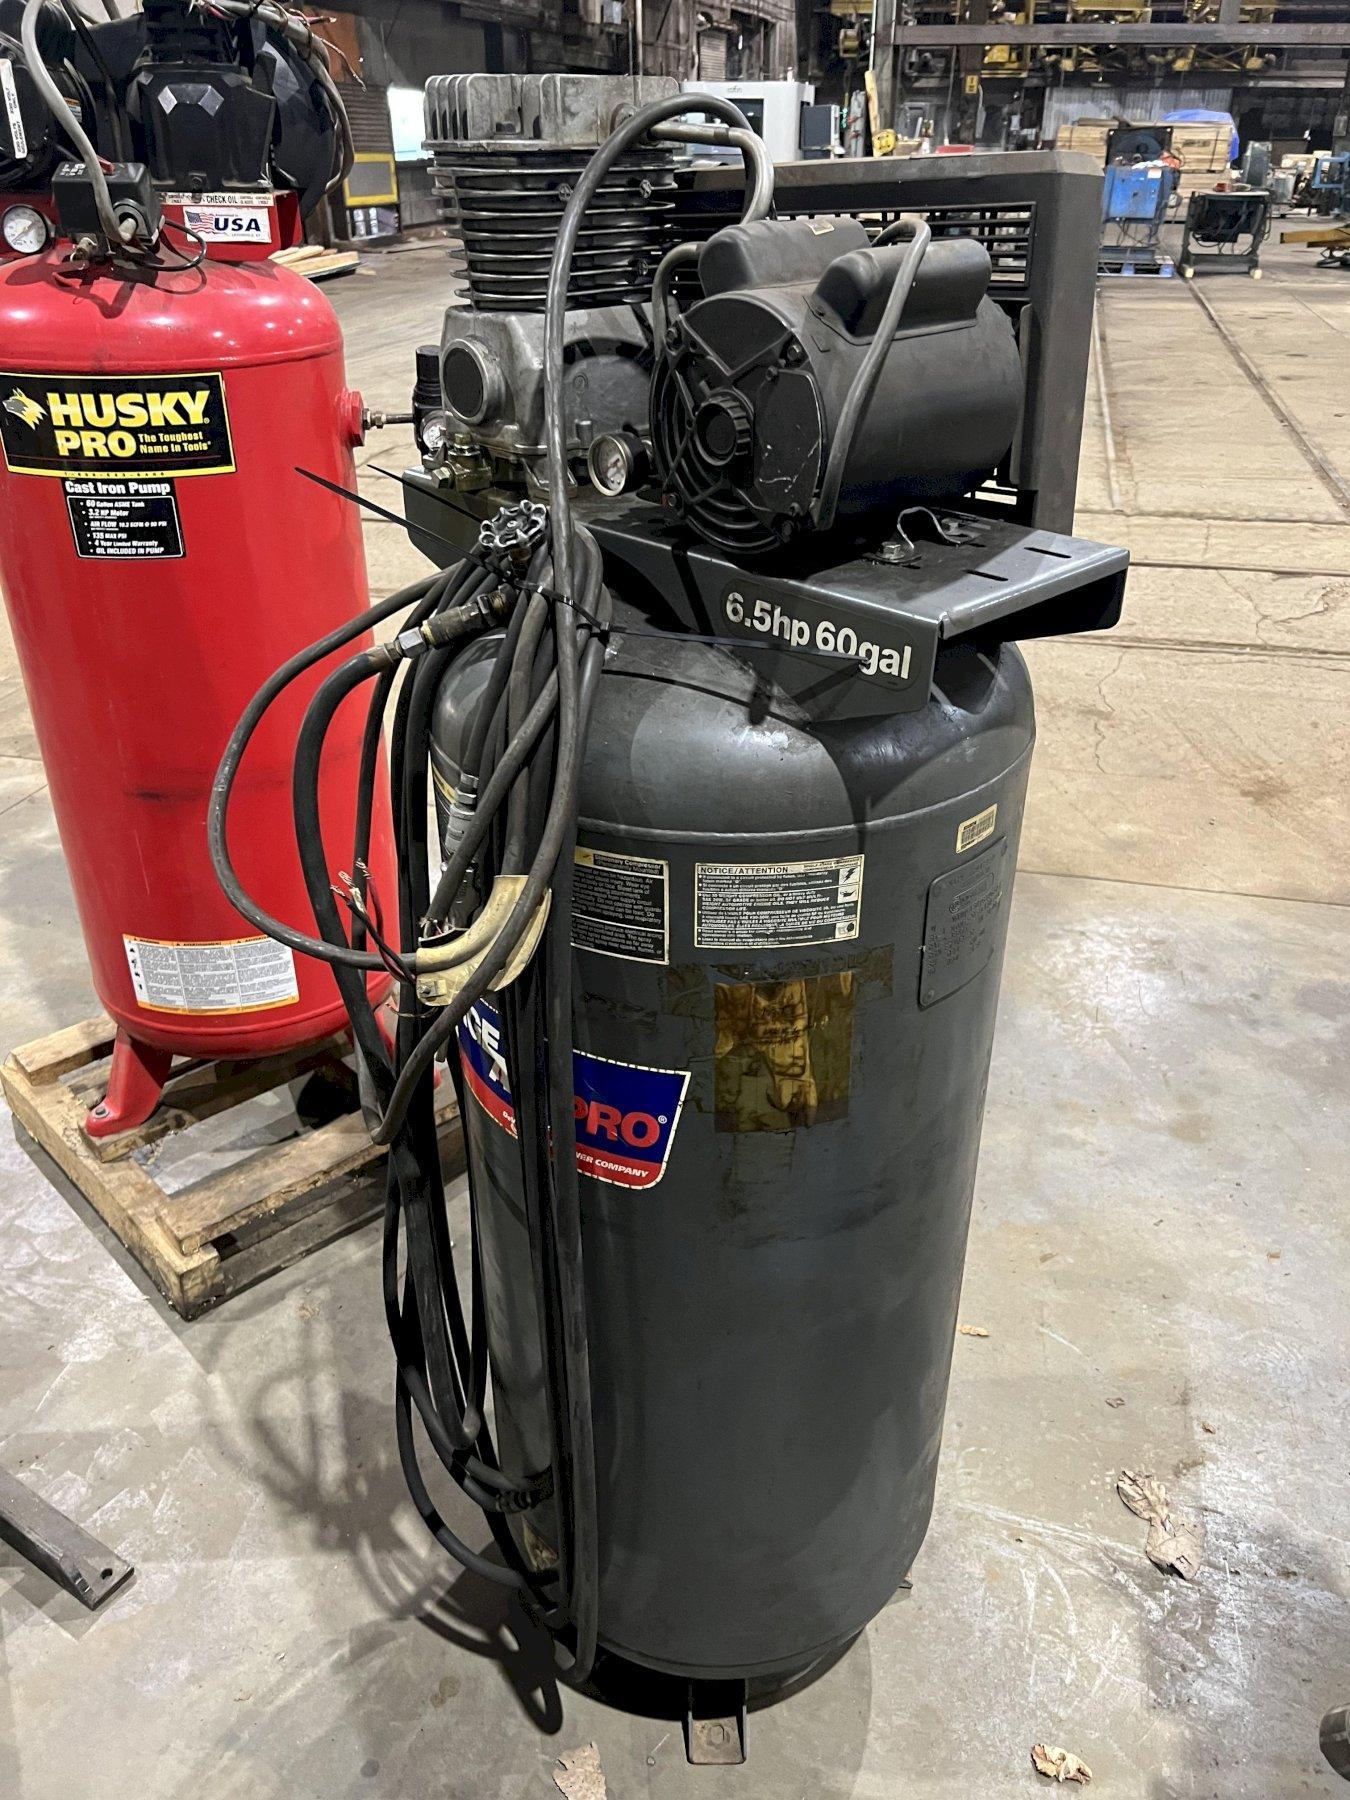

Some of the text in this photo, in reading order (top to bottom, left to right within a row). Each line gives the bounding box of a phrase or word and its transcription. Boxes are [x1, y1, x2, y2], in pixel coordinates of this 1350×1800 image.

[206, 195, 227, 204] CHECK
[227, 195, 238, 204] OIL
[214, 217, 261, 232] USA
[46, 390, 211, 428] HUSKY
[54, 430, 203, 458] PRO The Toughest
[139, 443, 169, 454] Name
[184, 441, 209, 452] Tools
[65, 480, 171, 496] Cast Iron Pump
[725, 592, 912, 680] 6.5hp 60gal
[700, 866, 789, 875] NOTICE/ATTENTION
[594, 1159, 649, 1178] COMPANY
